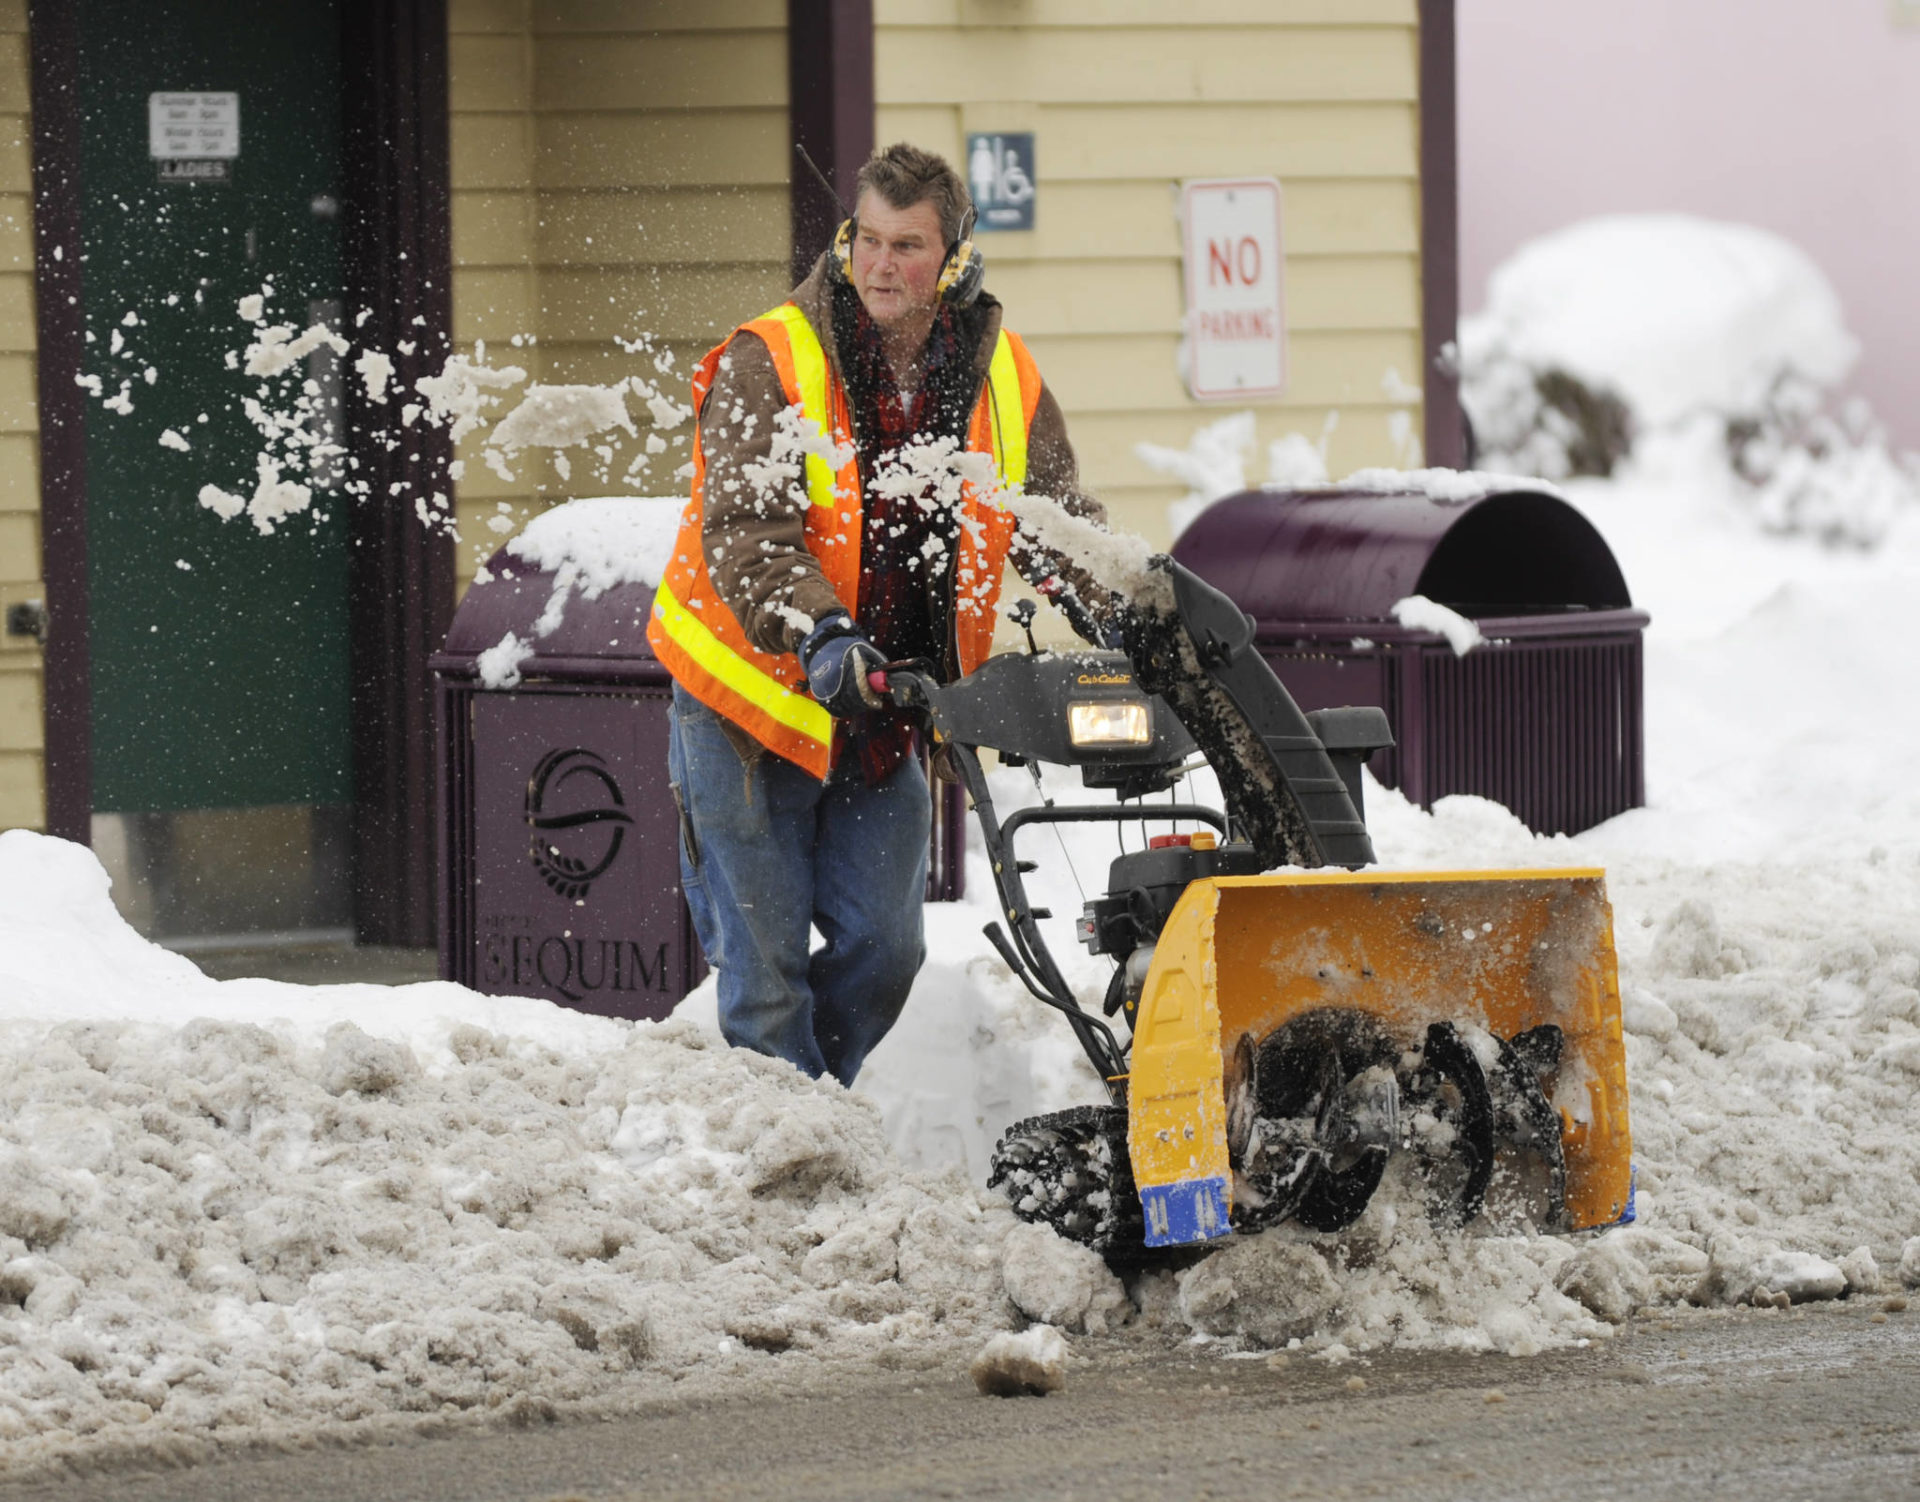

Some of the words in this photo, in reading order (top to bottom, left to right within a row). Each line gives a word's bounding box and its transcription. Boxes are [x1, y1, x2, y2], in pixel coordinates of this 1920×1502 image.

[162, 161, 225, 177] LADIES
[1208, 235, 1261, 287] NO
[1201, 308, 1273, 342] PARKING
[1077, 674, 1097, 684] Cub
[1098, 673, 1131, 684] Cadet
[485, 934, 670, 1002] SEQUIM
